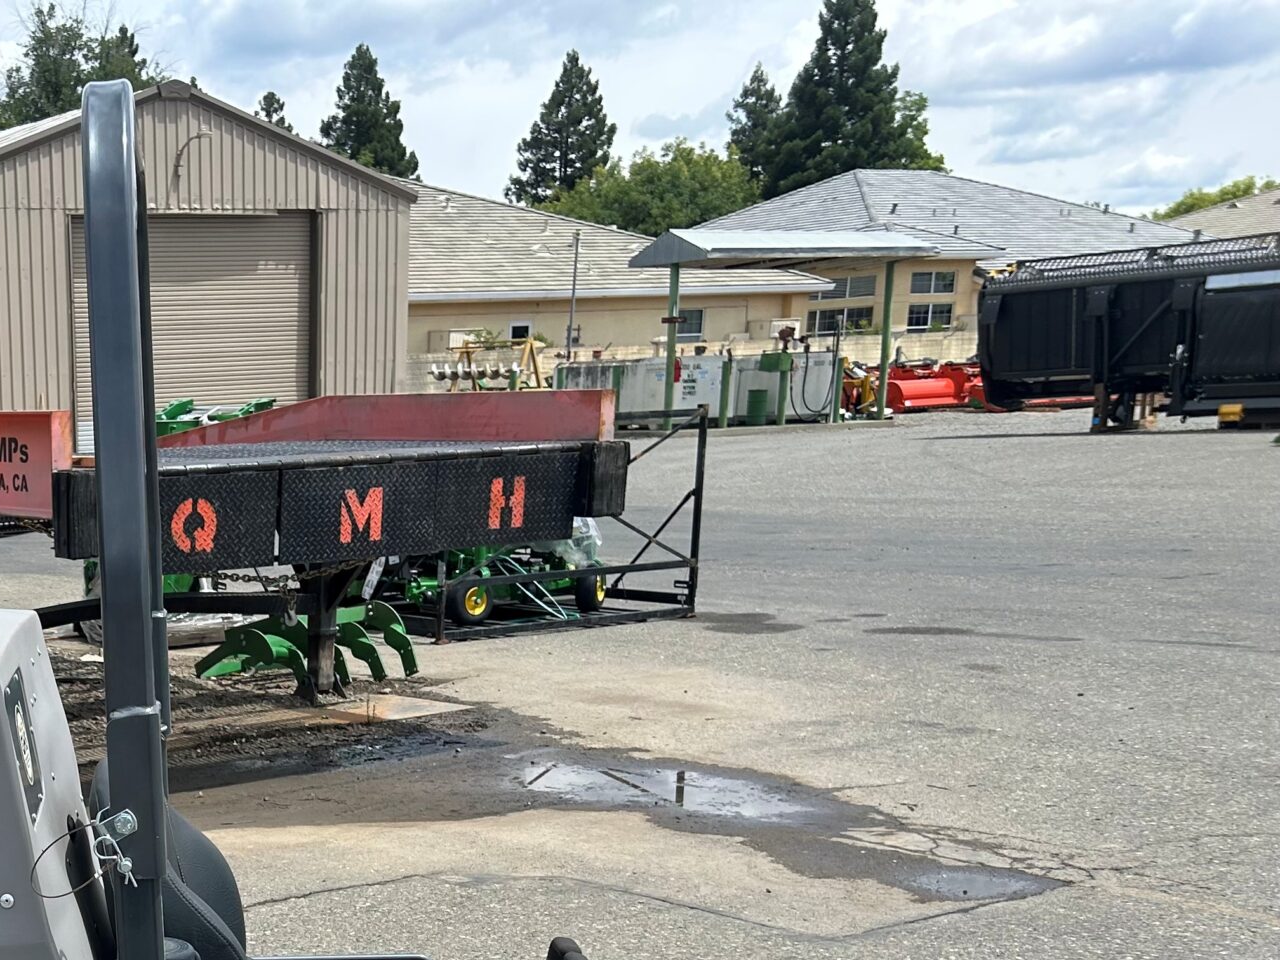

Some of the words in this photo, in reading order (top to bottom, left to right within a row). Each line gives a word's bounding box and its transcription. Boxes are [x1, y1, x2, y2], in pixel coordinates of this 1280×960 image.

[12, 474, 29, 492] CA
[339, 486, 384, 544] M
[488, 475, 526, 530] H
